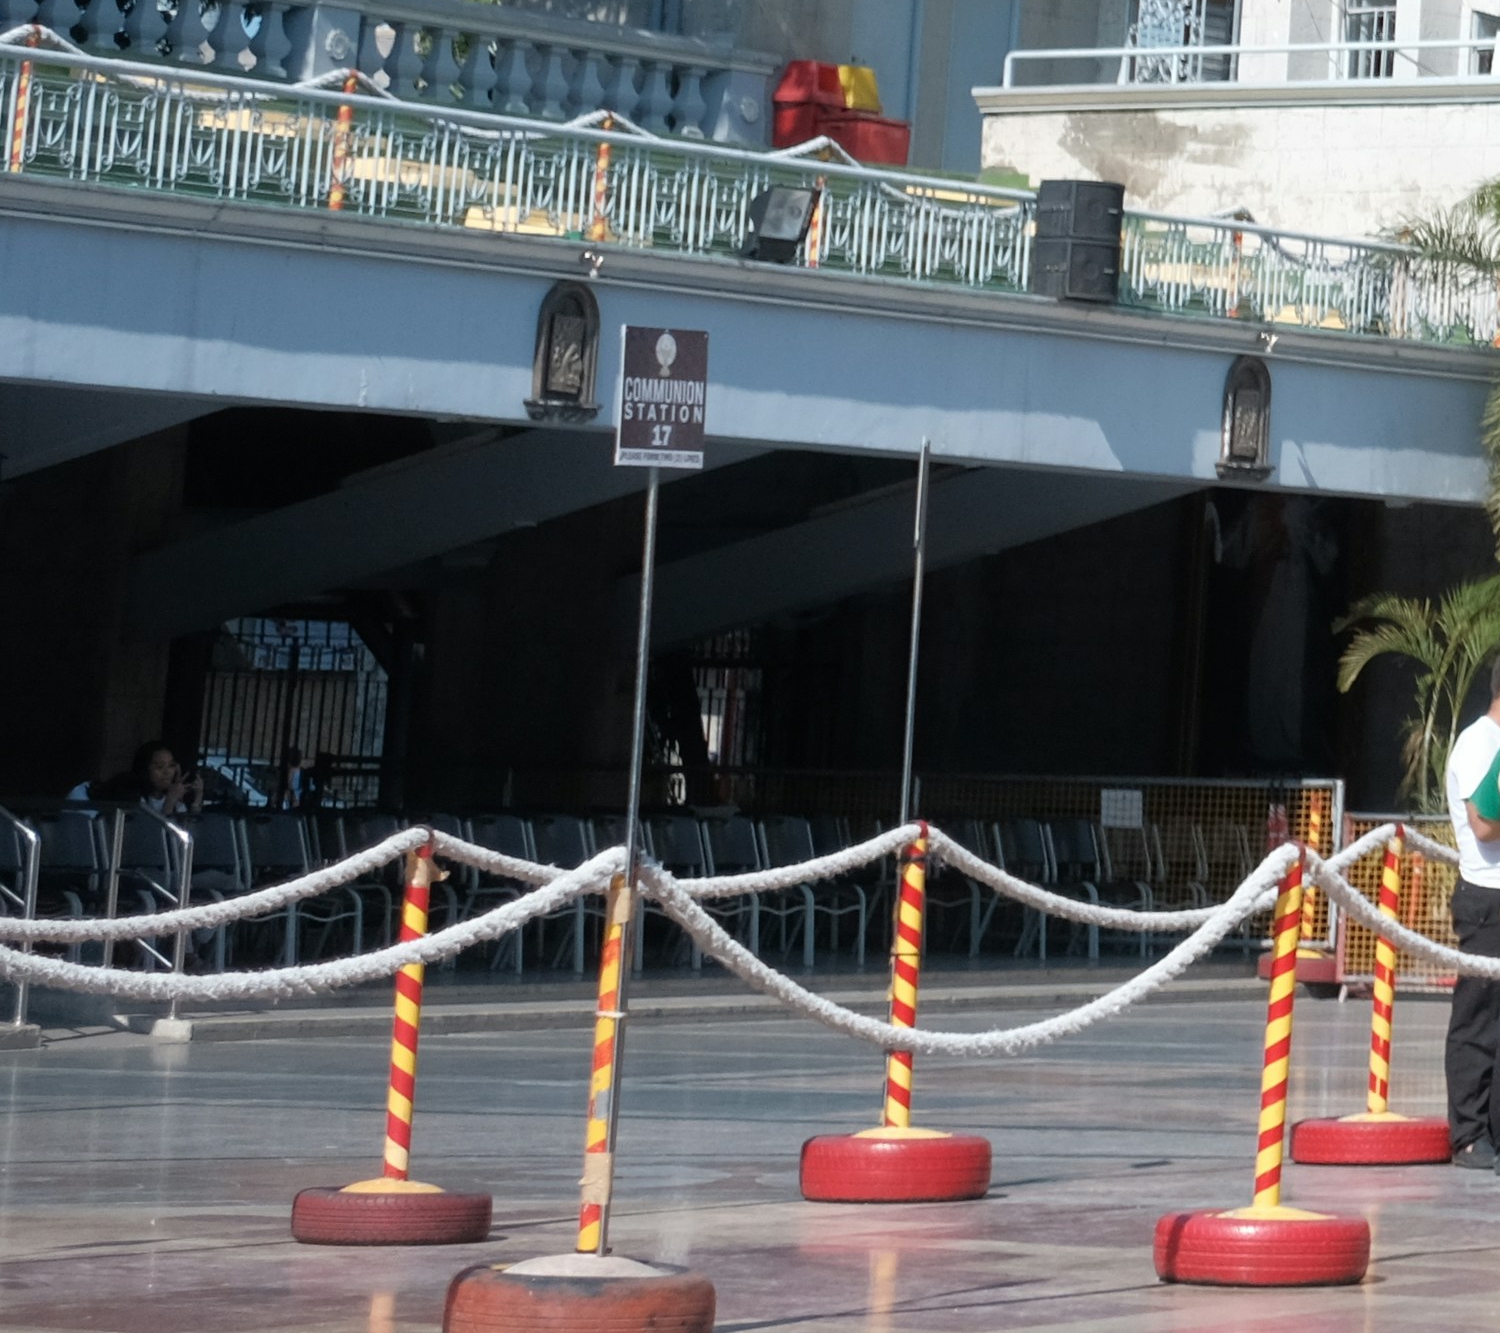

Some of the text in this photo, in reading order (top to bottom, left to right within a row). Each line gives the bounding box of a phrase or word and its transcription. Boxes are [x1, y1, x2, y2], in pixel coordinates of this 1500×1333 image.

[624, 376, 704, 406] COMMUNION
[624, 402, 703, 424] STATION
[651, 424, 673, 446] 17
